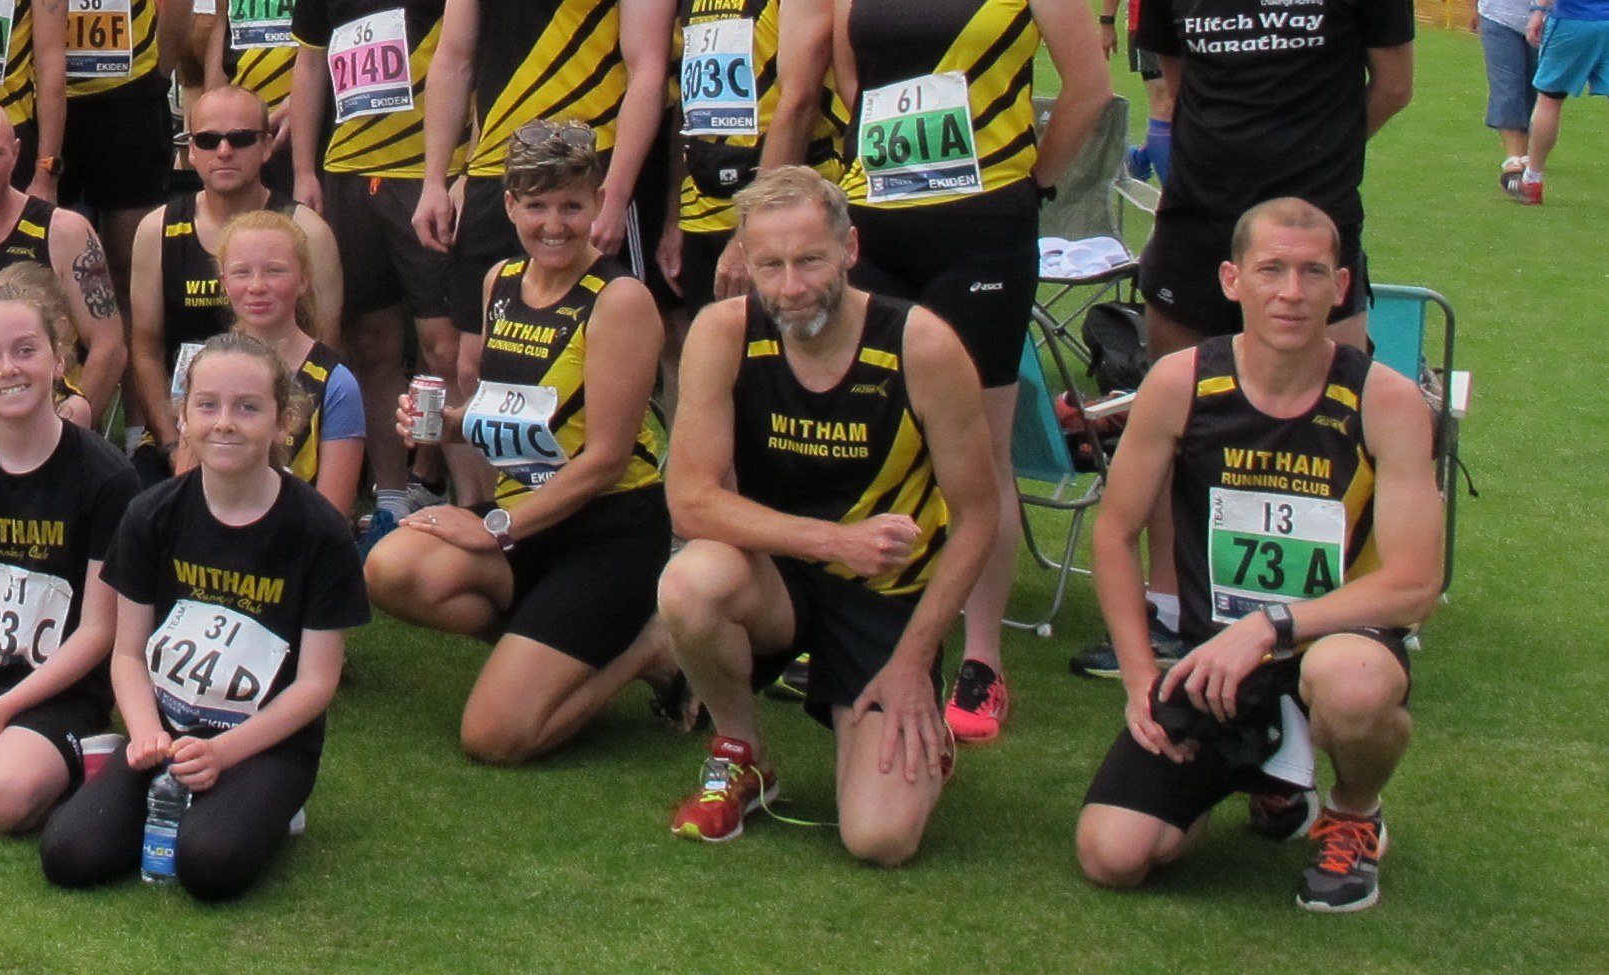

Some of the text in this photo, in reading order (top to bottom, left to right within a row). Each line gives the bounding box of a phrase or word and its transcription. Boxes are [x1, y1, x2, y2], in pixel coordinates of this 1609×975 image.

[352, 21, 373, 46] 36
[1184, 10, 1325, 35] Flitch Way
[700, 26, 720, 53] 51
[1186, 33, 1326, 54] Marathon
[95, 62, 128, 72] EKIDEN
[370, 95, 409, 108] EKIDEN
[896, 85, 922, 113] 61
[710, 116, 754, 128] EKIDEN
[928, 173, 976, 189] EKIDEN
[184, 296, 230, 307] RUNNING
[491, 319, 556, 344] WITHAM
[487, 337, 550, 359] RUNNING CLUB
[498, 389, 526, 416] 80
[770, 412, 868, 442] WITHAM
[768, 436, 870, 458] RUNNING CLUB
[1223, 446, 1332, 479] WITHAM
[1221, 471, 1331, 496] RUNNING CLUB
[1213, 495, 1224, 527] TEAM
[1262, 501, 1295, 535] 13
[28, 544, 50, 560] Club
[1232, 537, 1336, 596] 73 A
[173, 558, 285, 604] WITHAM
[167, 605, 189, 631] TEAM
[236, 597, 263, 615] Club
[203, 614, 243, 647] 31
